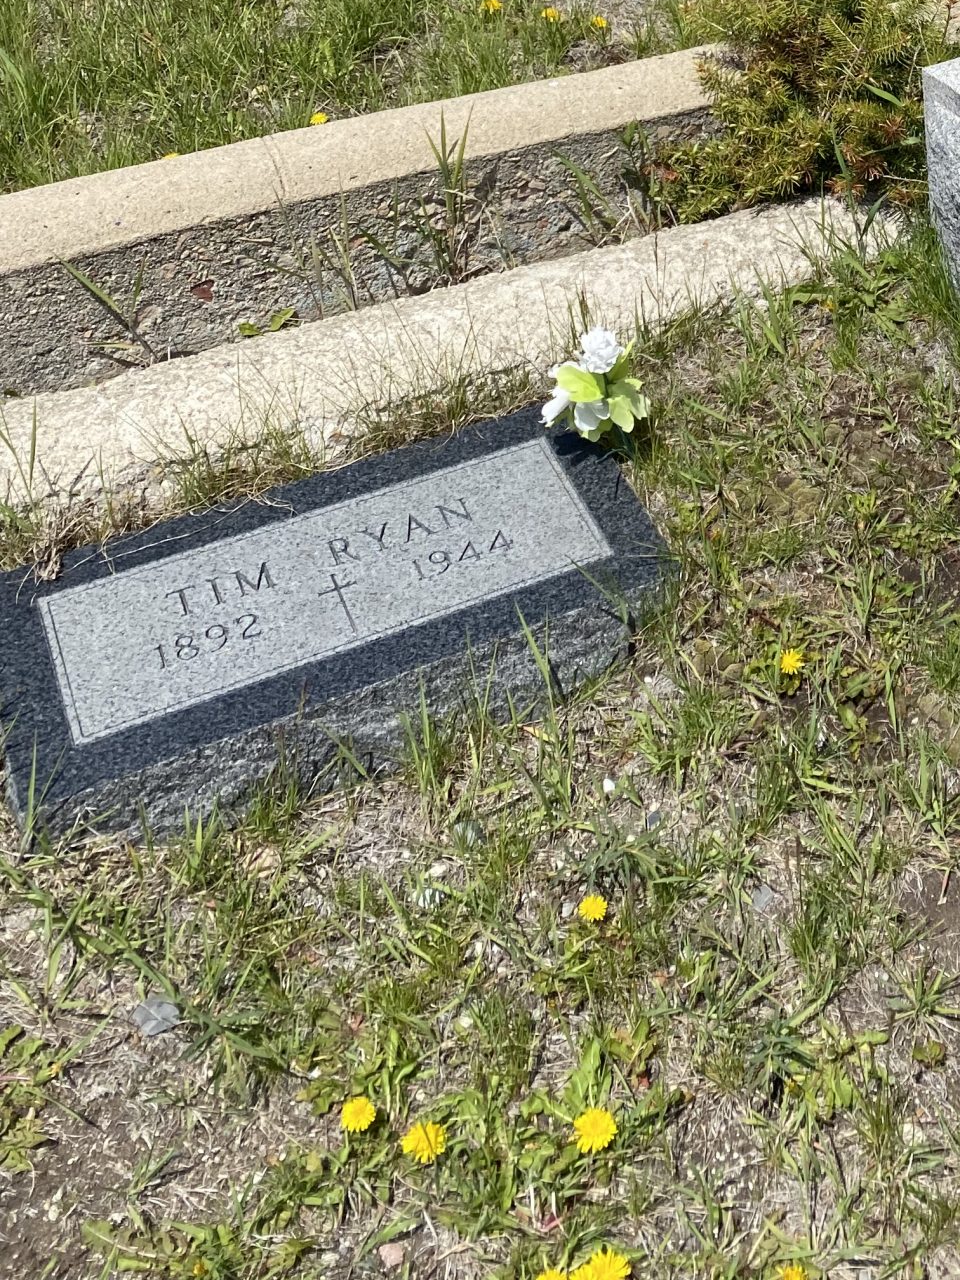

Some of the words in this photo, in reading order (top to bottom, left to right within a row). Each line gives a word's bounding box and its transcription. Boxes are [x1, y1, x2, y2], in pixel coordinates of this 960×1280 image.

[153, 613, 264, 670] 1892
[411, 529, 514, 581] 1944
[164, 560, 278, 617] TIM
[328, 497, 473, 566] RYAN
